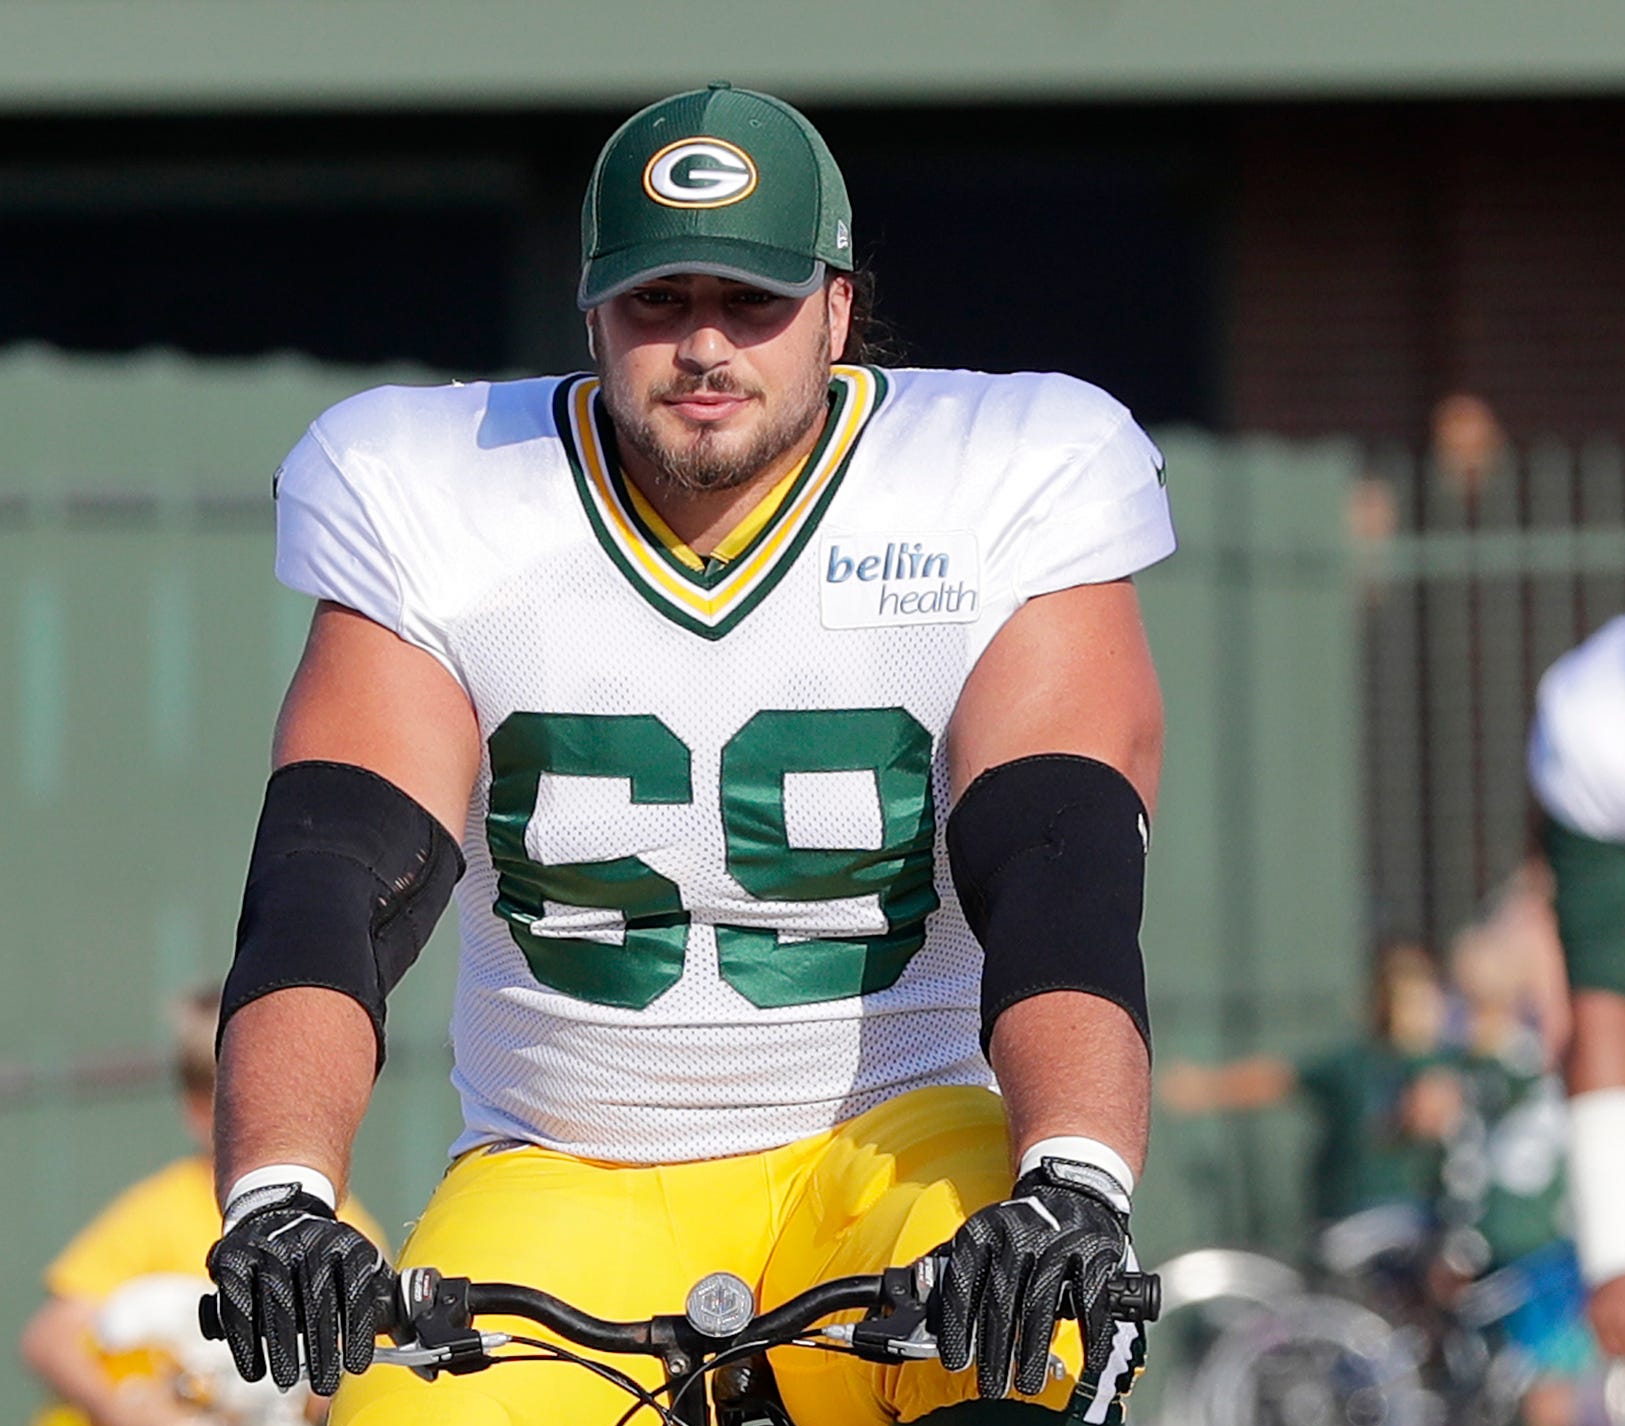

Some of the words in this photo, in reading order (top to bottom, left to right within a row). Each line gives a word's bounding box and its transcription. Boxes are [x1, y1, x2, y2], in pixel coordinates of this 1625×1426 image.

[648, 141, 753, 204] G
[826, 542, 951, 583] bellin
[878, 581, 978, 616] health
[486, 706, 940, 1011] 69
